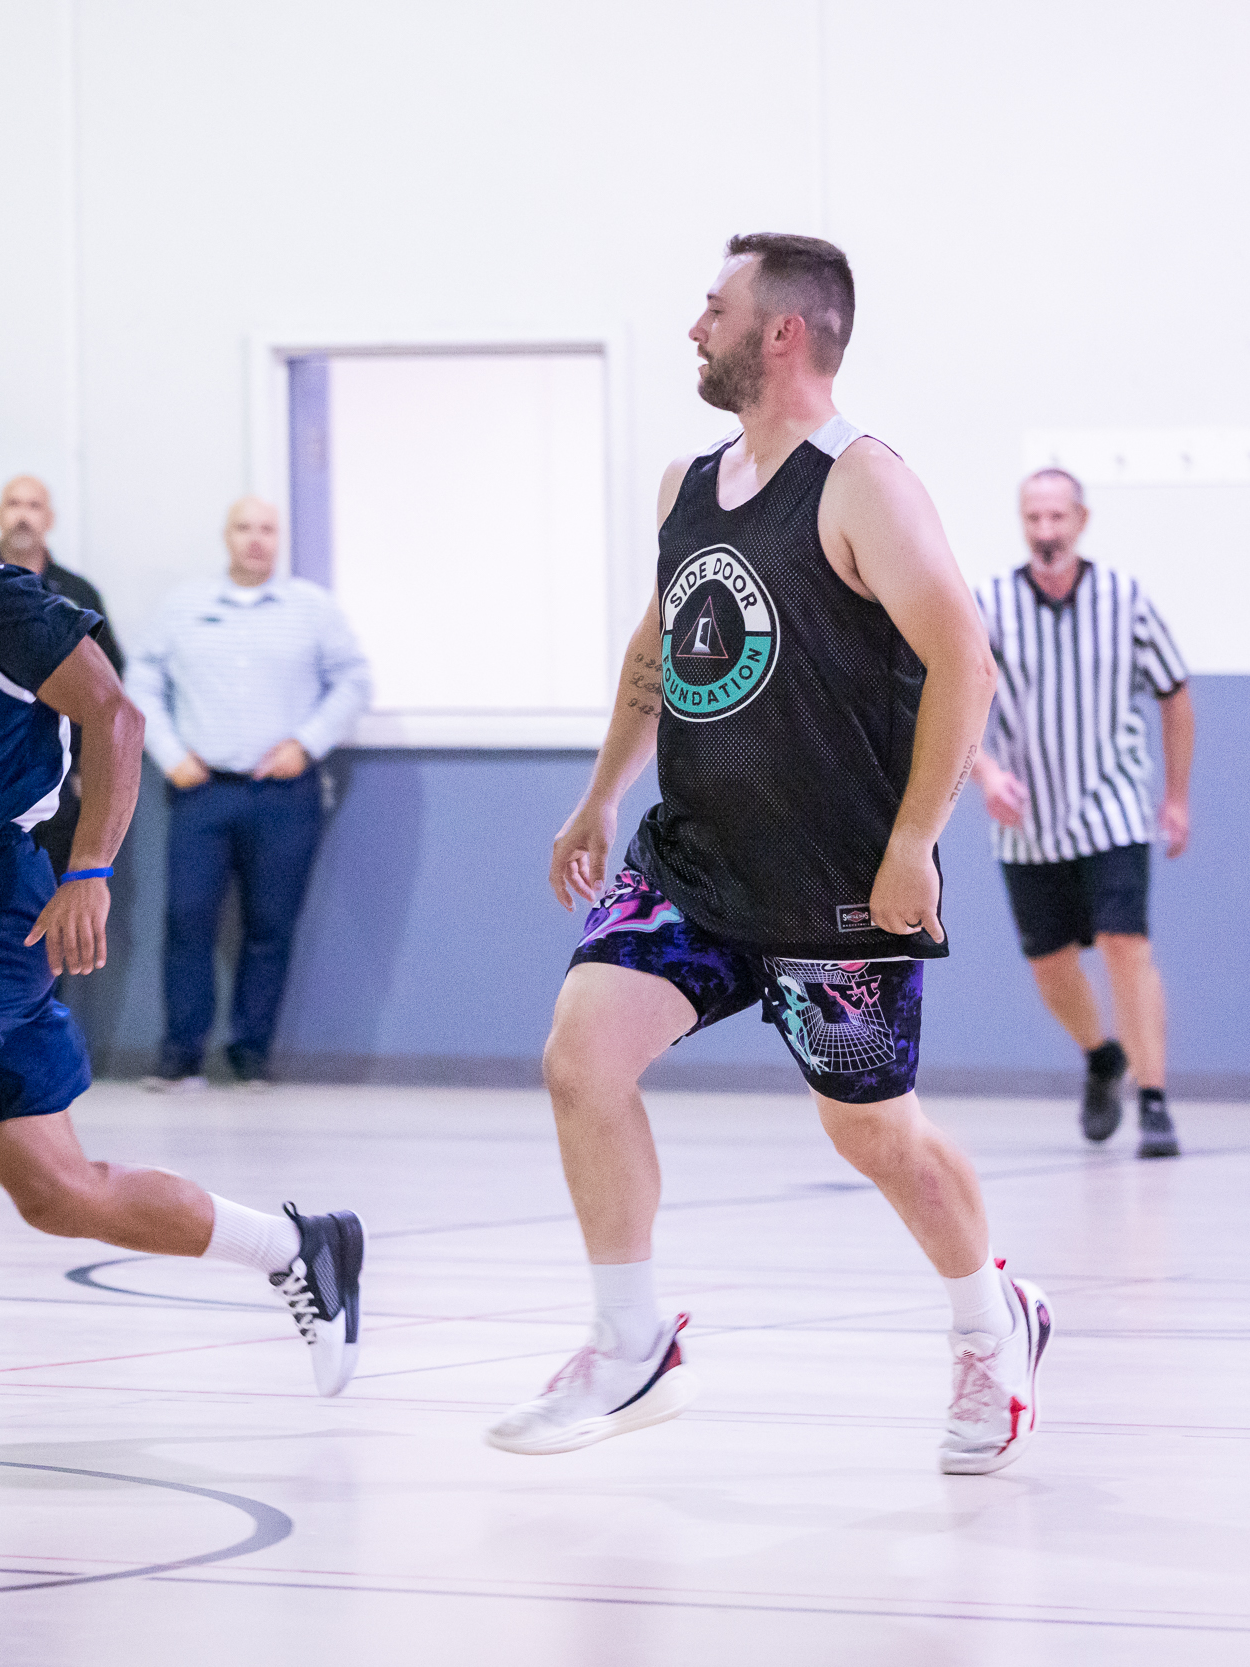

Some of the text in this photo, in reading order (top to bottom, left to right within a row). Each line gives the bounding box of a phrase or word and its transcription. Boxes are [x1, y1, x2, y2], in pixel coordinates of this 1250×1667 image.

[670, 558, 757, 610] SIDE DOOR
[662, 648, 762, 706] FOUNDATION
